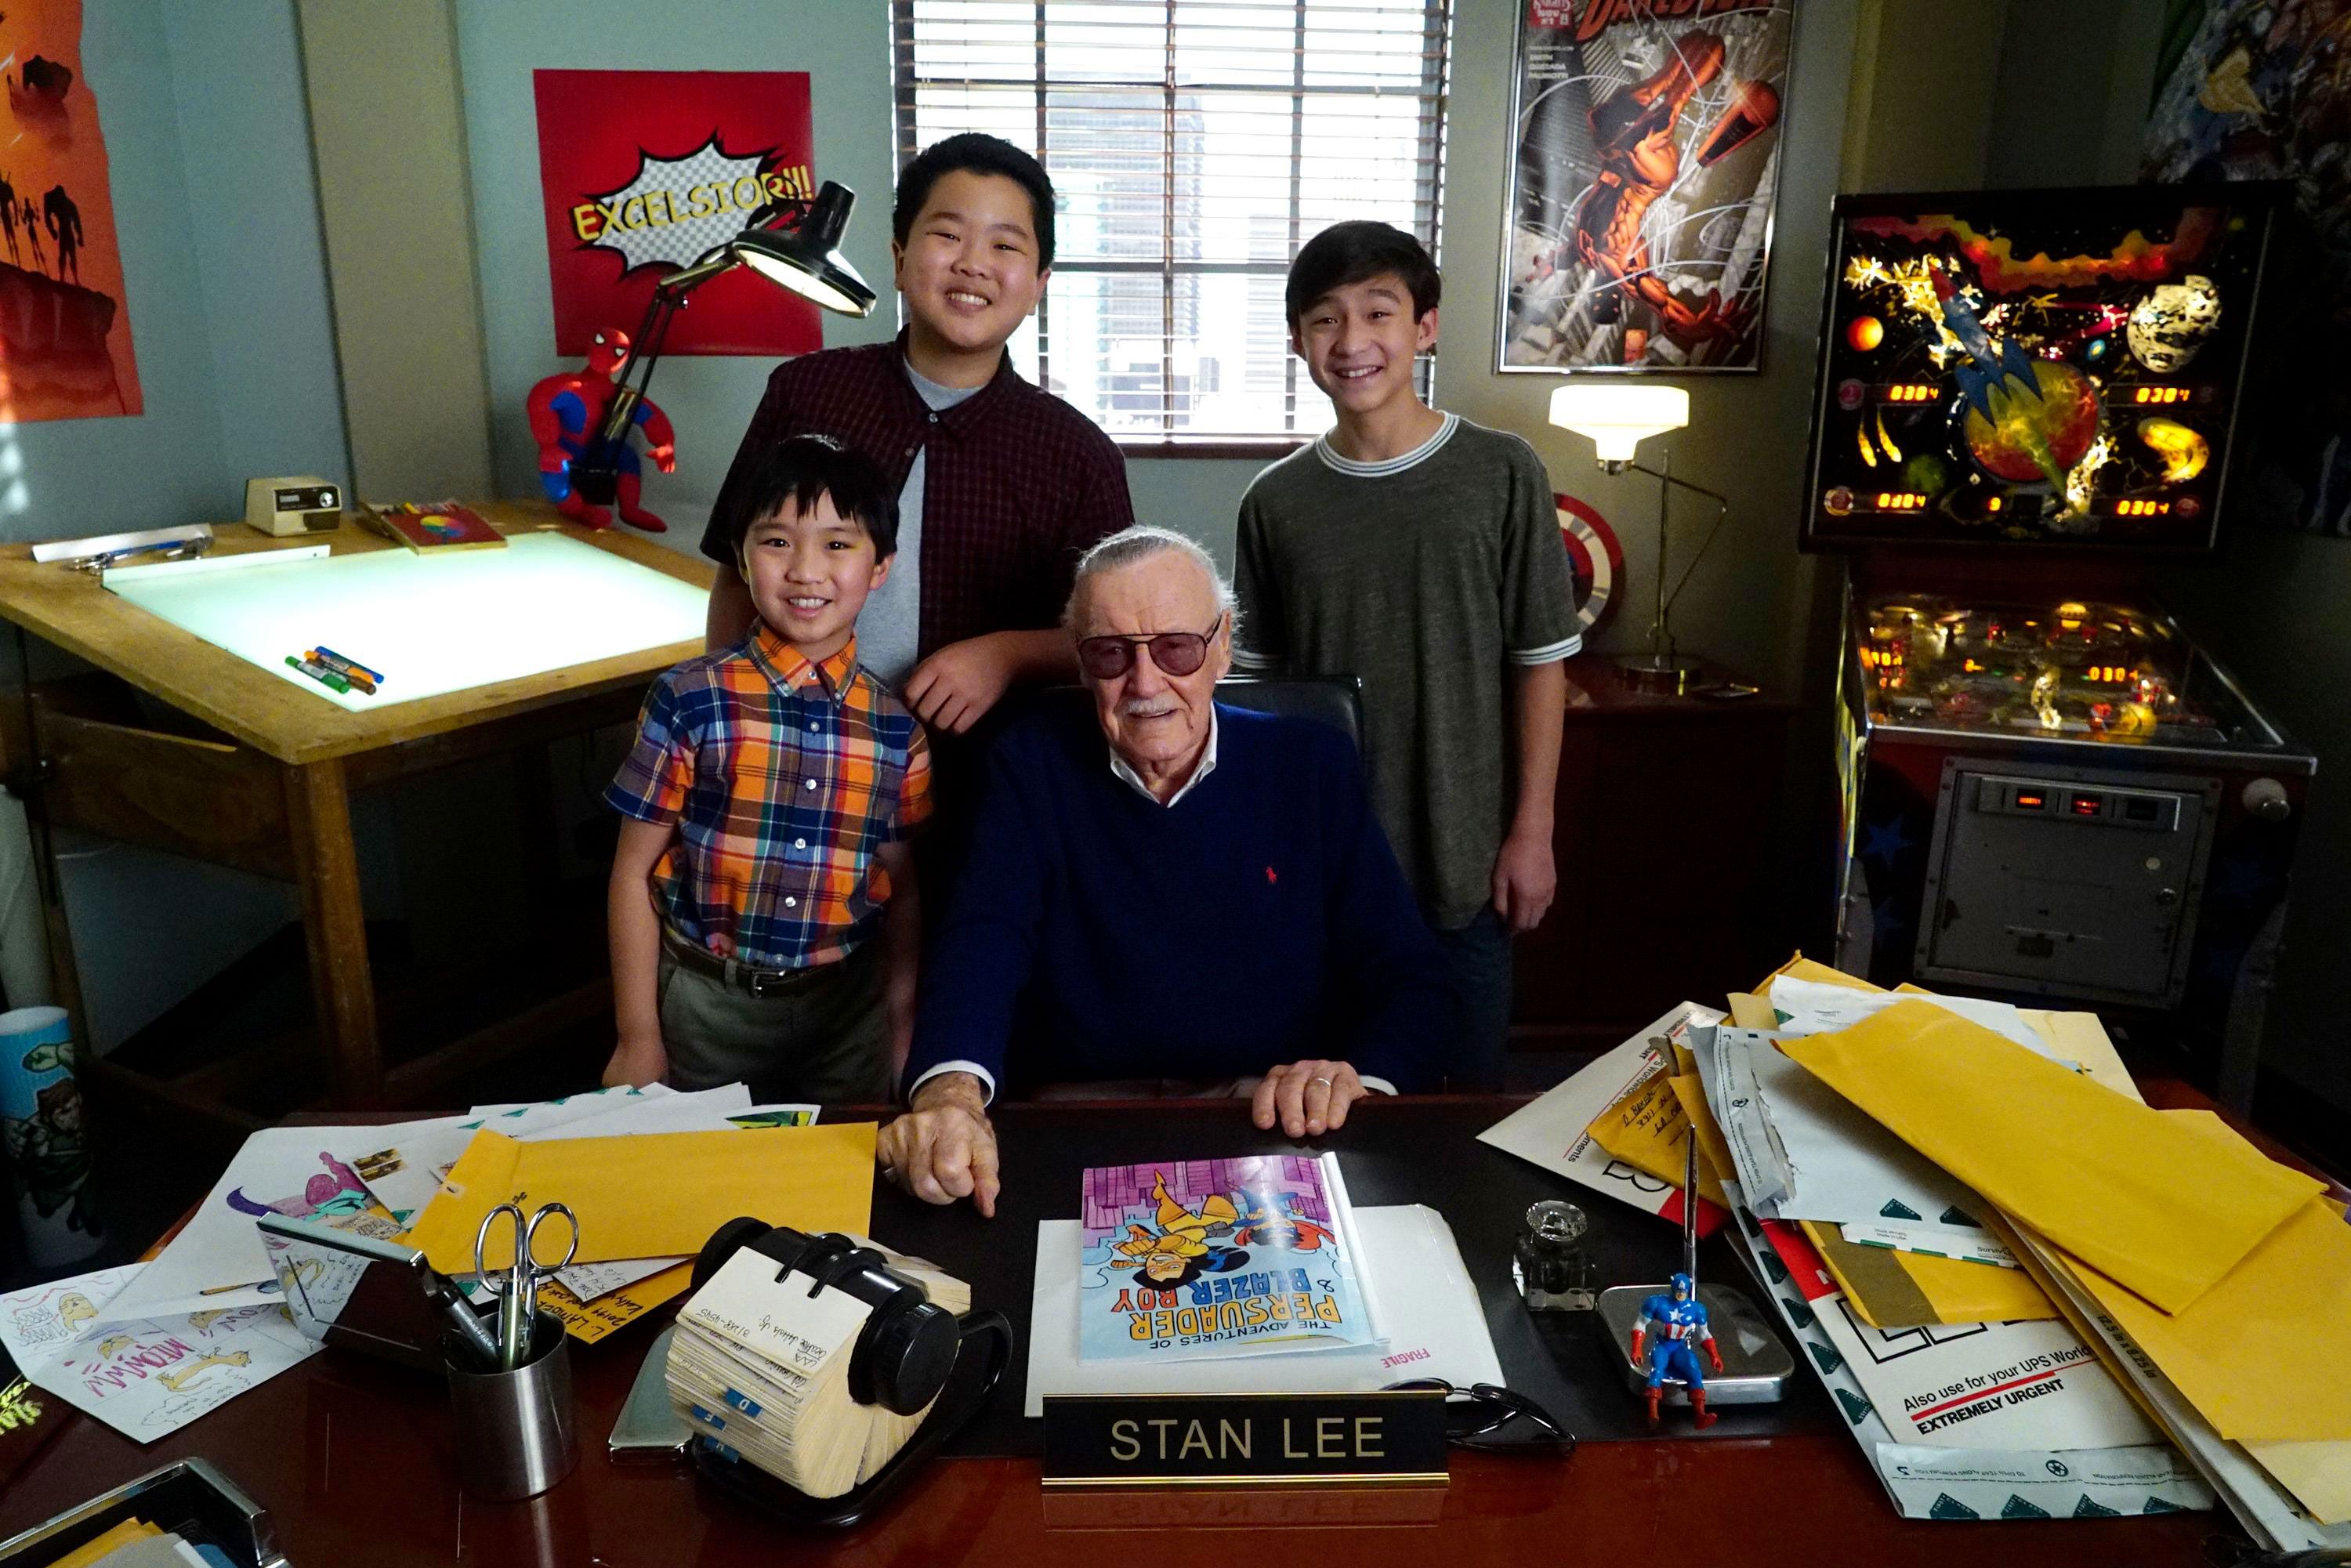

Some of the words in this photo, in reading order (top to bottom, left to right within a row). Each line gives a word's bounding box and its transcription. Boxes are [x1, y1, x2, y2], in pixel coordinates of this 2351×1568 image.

[1191, 1267, 1313, 1305] BLAZER
[1129, 1292, 1342, 1342] PERSUADER
[1180, 1321, 1289, 1347] ADVENTURES
[1298, 1320, 1332, 1331] THE
[1150, 1339, 1171, 1349] OF
[1380, 1347, 1432, 1369] FRAGILE
[1904, 1392, 1937, 1412] Also
[1938, 1382, 1965, 1398] use
[1965, 1374, 1987, 1389] for
[1987, 1366, 2020, 1385] your
[2021, 1355, 2052, 1373] UPS
[1916, 1396, 2003, 1436] EXTREMELY
[2004, 1378, 2065, 1406] URGENT
[1110, 1418, 1251, 1461] STAN
[1284, 1417, 1385, 1459] LEE
